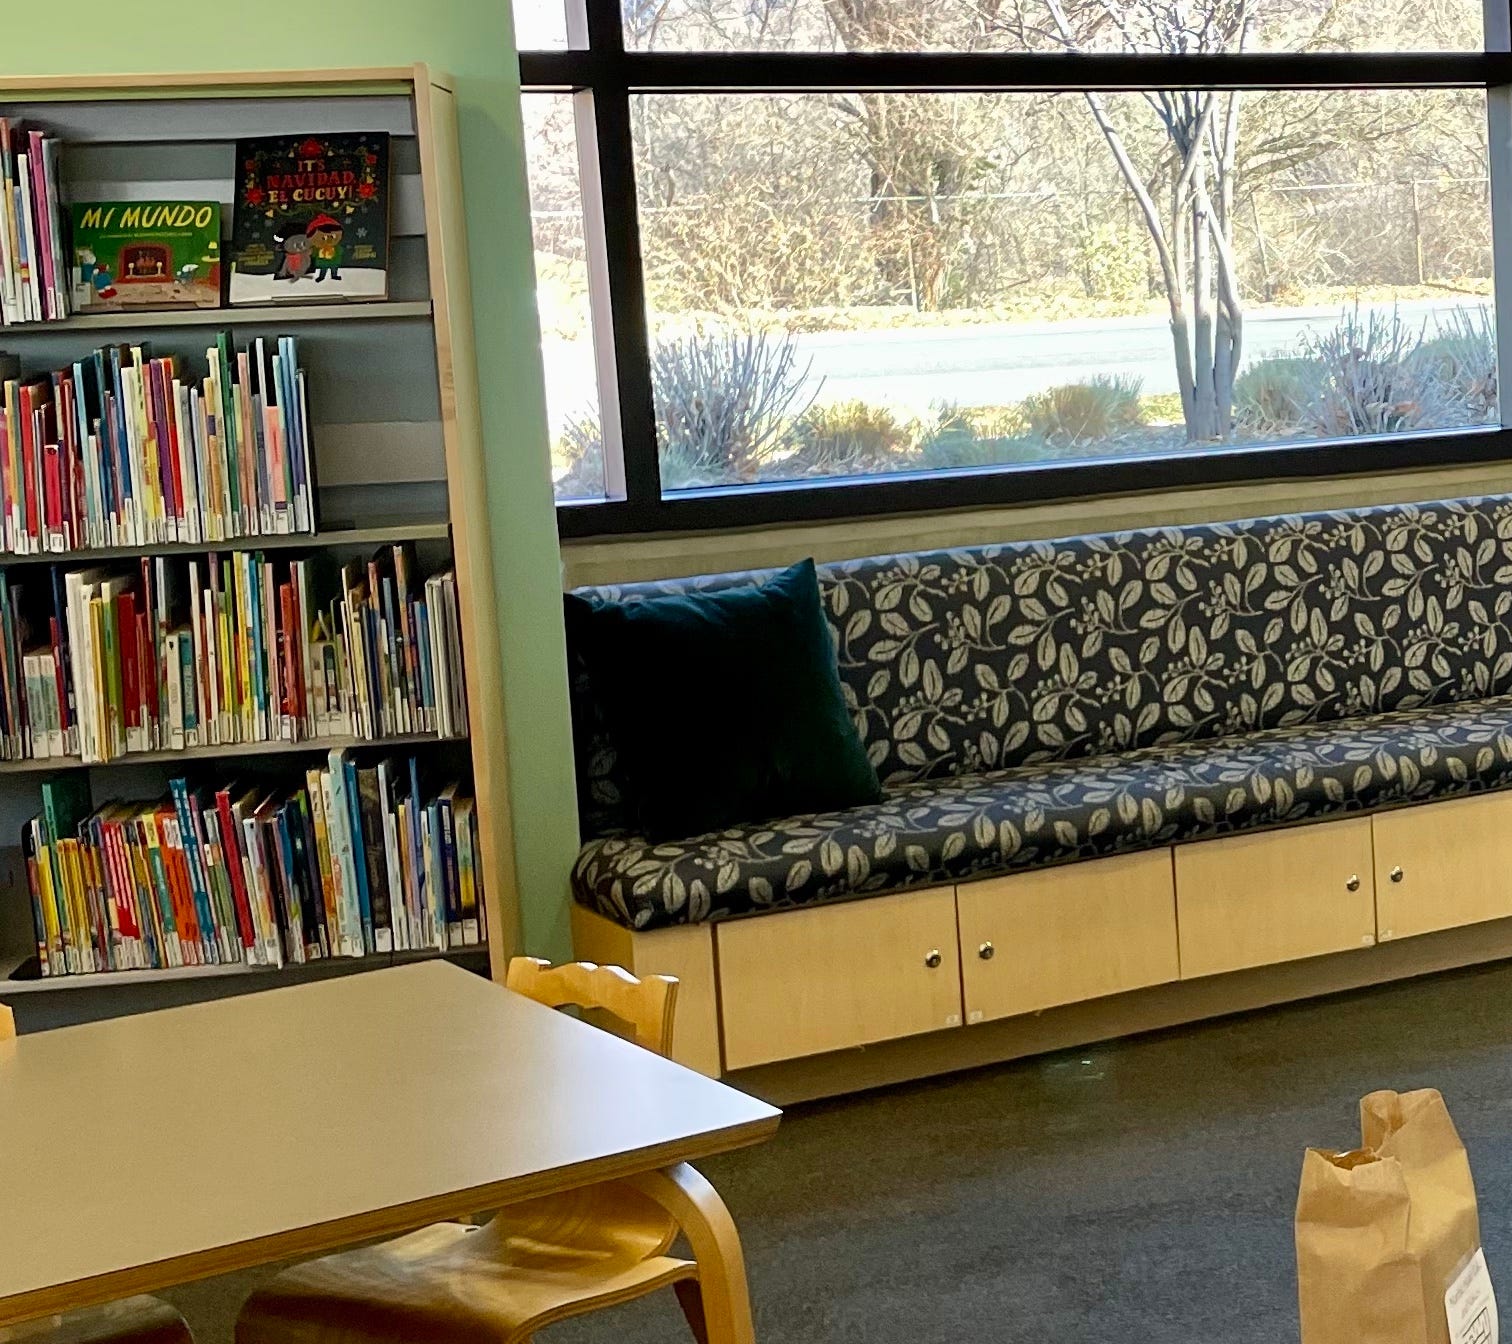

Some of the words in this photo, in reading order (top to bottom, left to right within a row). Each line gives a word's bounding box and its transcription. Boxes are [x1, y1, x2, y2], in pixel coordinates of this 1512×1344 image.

[268, 190, 288, 203] EL
[80, 207, 115, 228] MI
[119, 205, 212, 228] MUNDO
